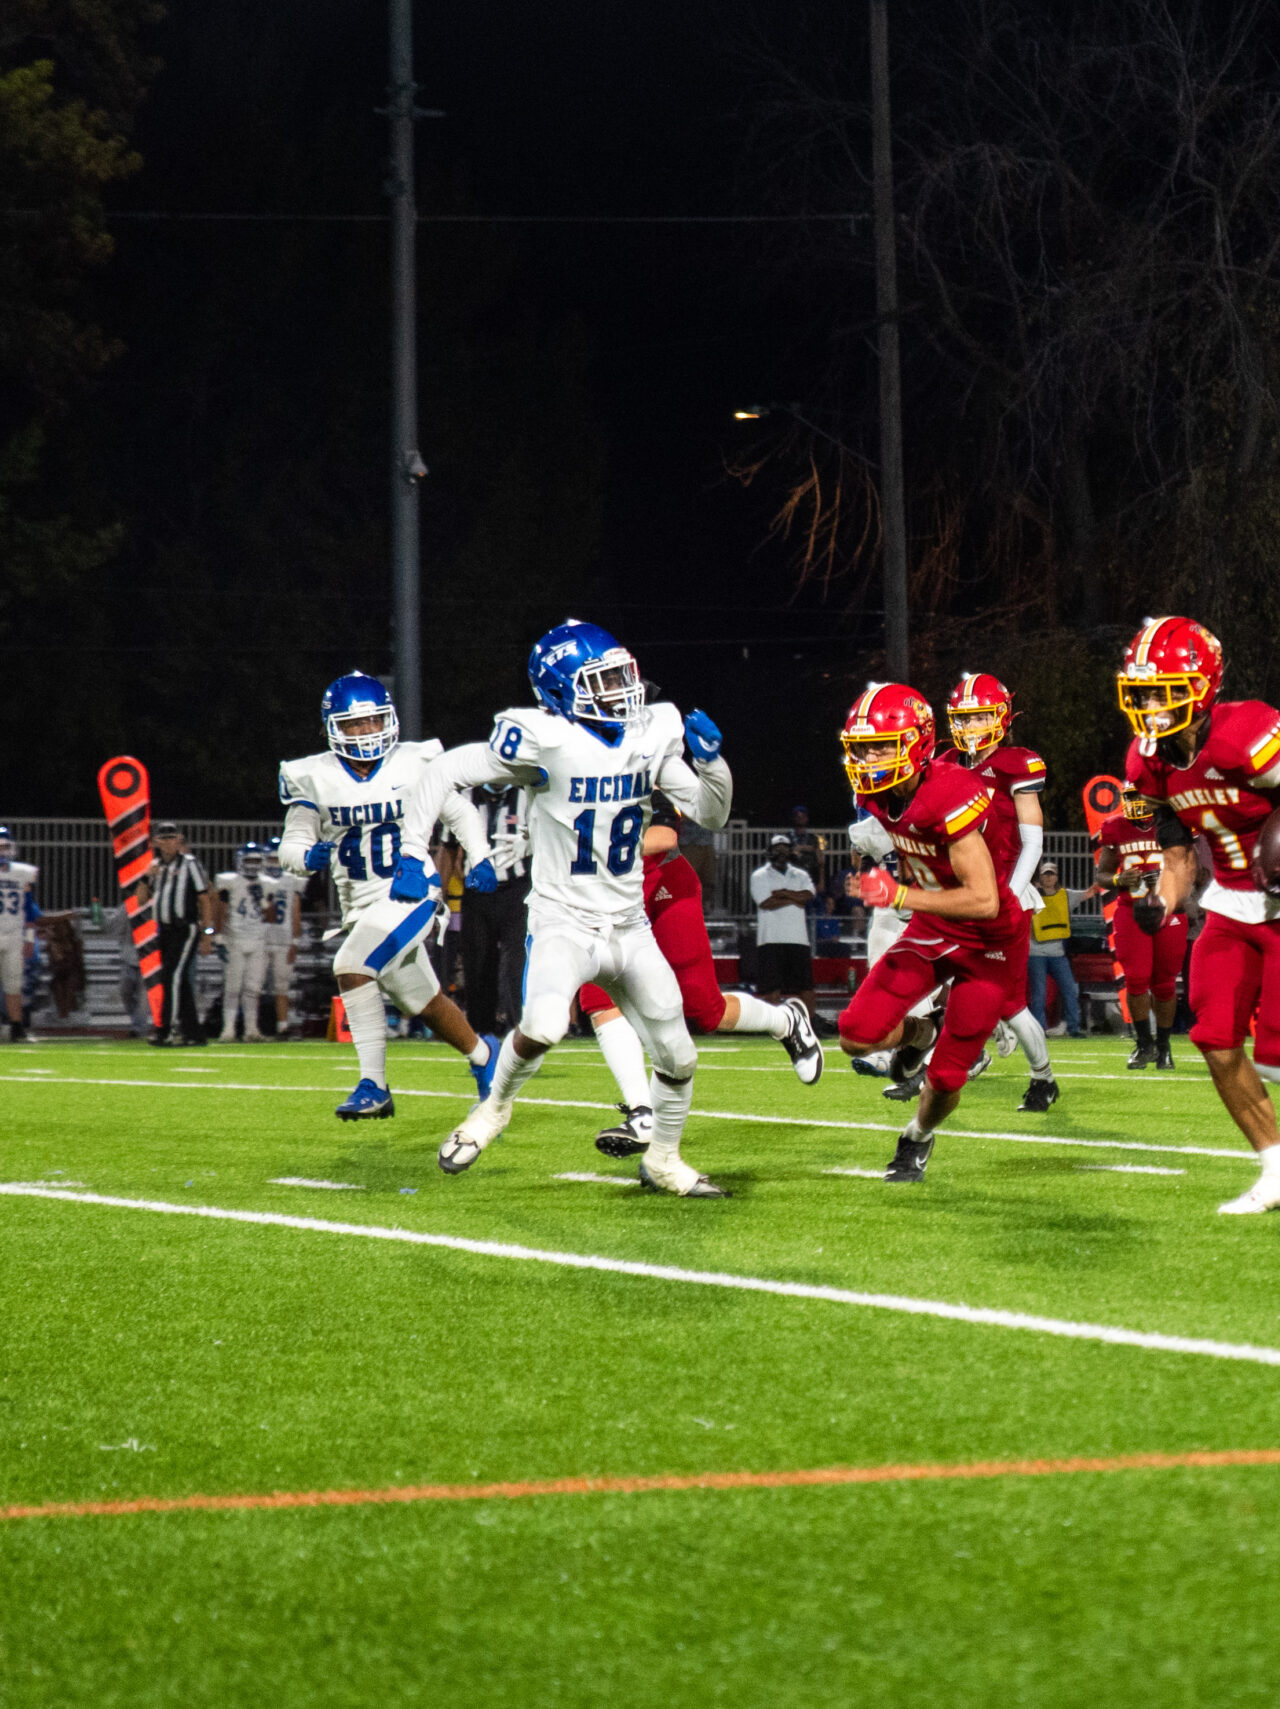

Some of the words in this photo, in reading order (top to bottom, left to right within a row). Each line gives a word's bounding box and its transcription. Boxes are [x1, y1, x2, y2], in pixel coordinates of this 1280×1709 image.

[569, 770, 652, 803] ENCINAL
[328, 800, 404, 827] ENCINAL
[338, 823, 401, 880] 40
[571, 803, 644, 876] 18
[1119, 840, 1163, 855] BERKEL
[1202, 809, 1247, 870] 1
